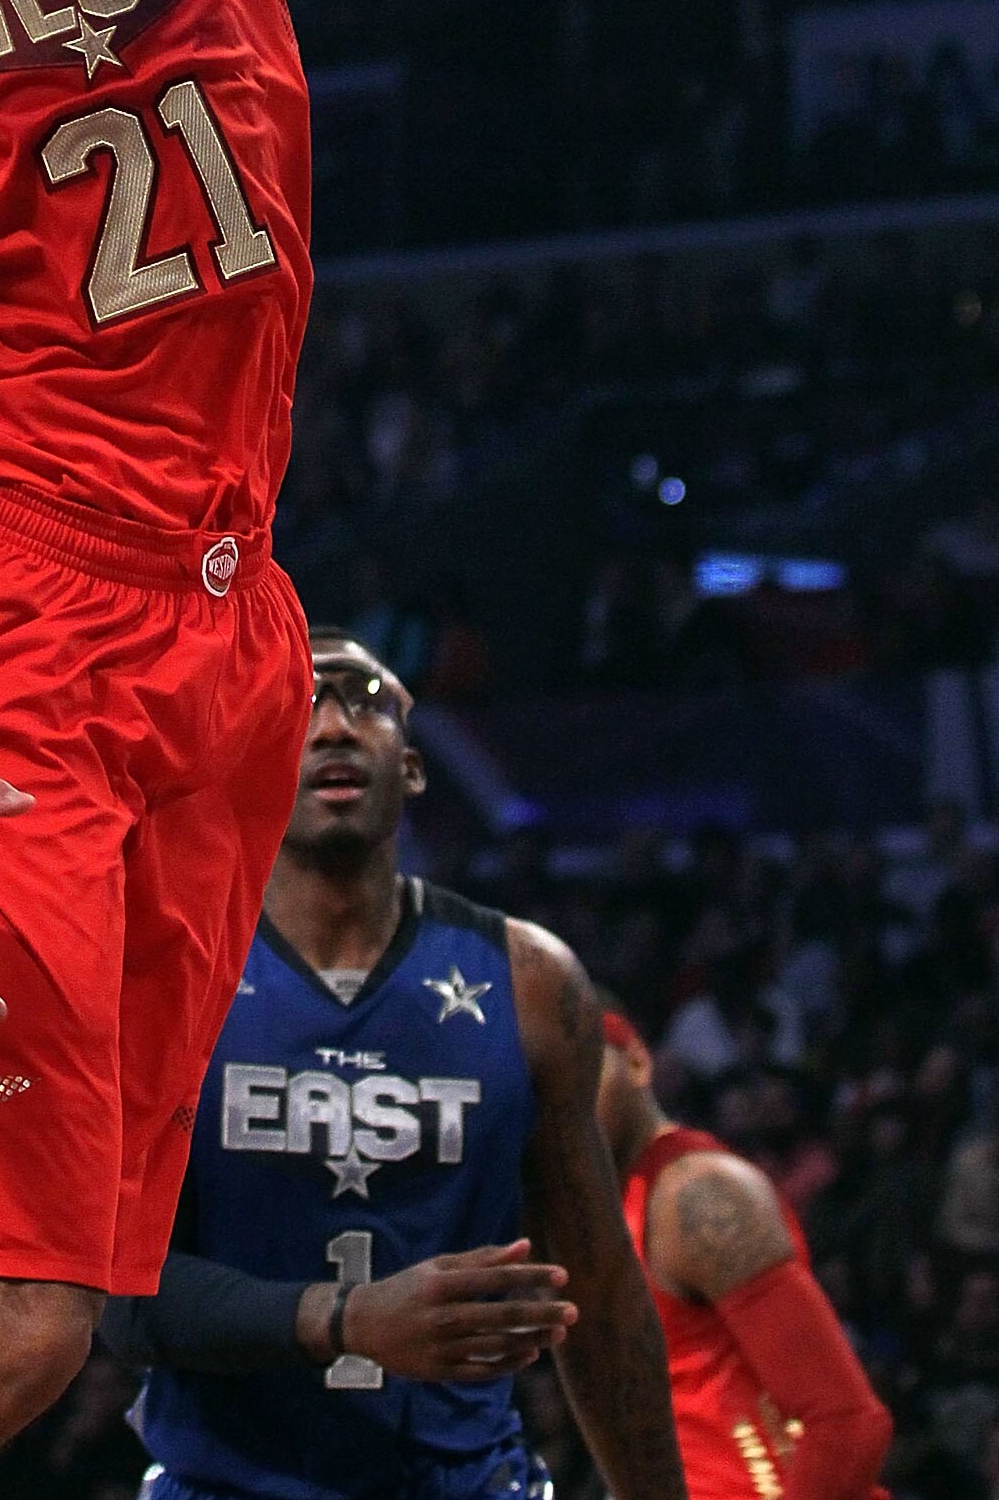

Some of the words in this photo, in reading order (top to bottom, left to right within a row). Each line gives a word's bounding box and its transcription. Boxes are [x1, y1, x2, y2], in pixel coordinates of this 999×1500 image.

[39, 79, 278, 325] 21
[220, 1061, 482, 1165] EAST
[314, 1047, 387, 1070] THE
[325, 1230, 384, 1390] 1
